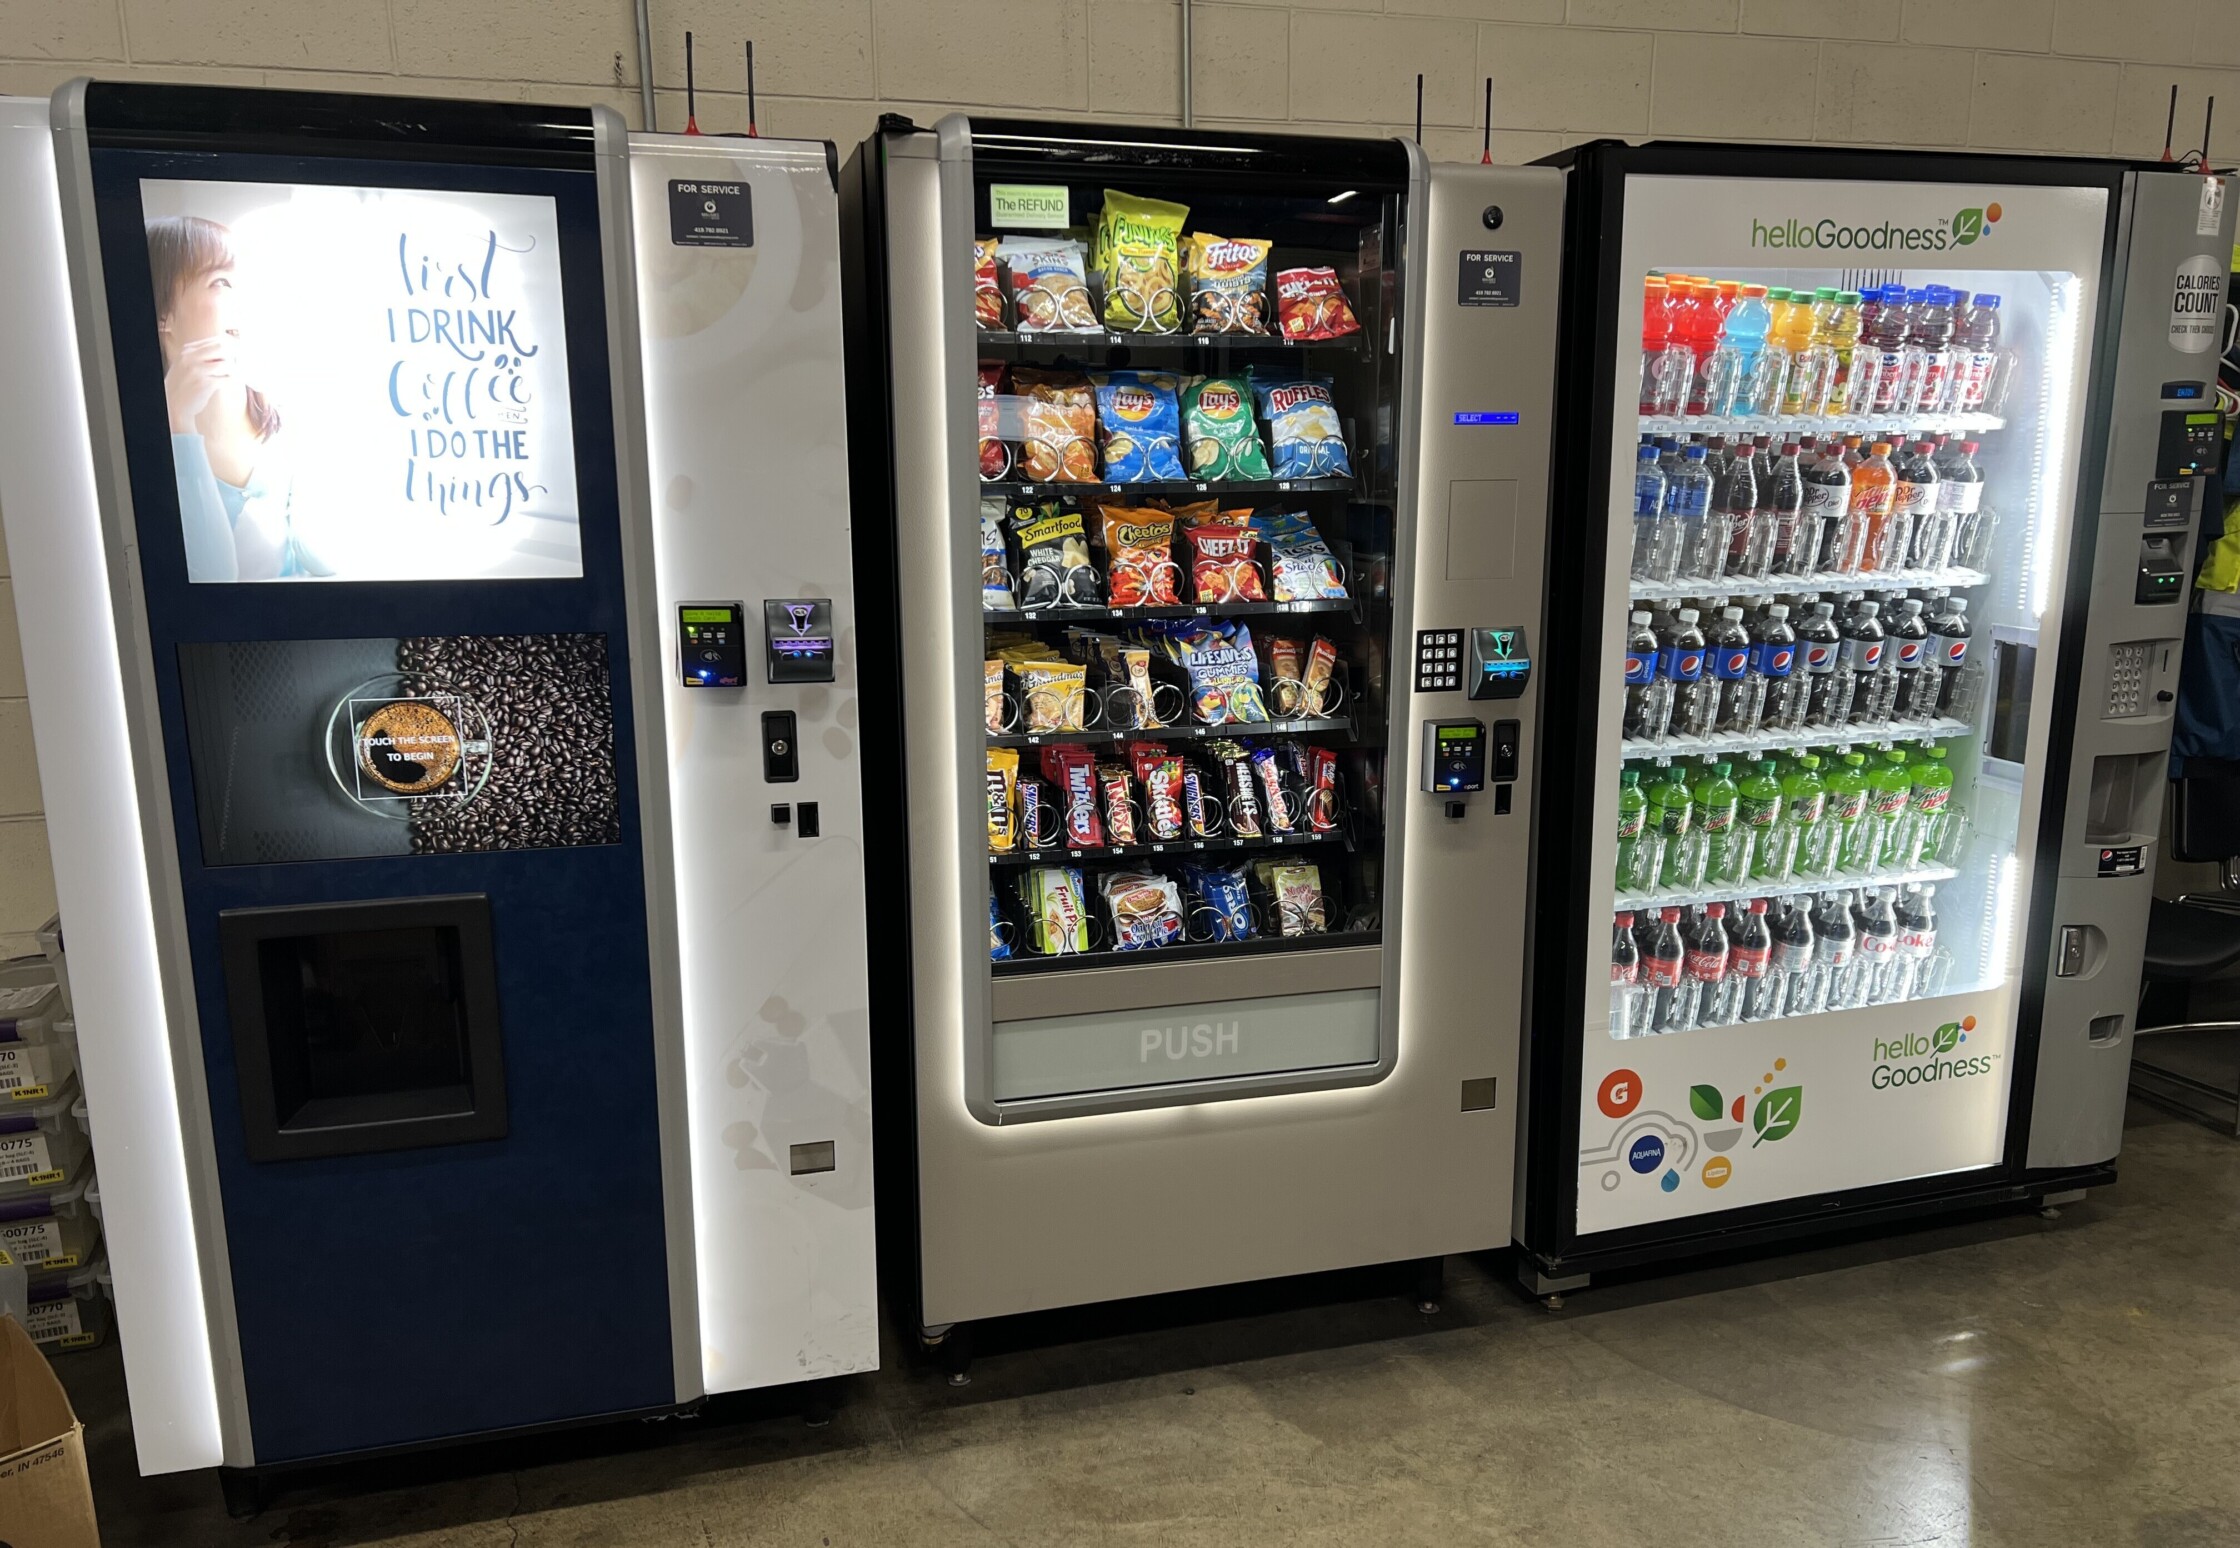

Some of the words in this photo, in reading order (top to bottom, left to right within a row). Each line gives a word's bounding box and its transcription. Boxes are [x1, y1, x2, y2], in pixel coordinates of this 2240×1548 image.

[678, 184, 697, 193] FOR
[701, 185, 740, 195] SERVICE
[996, 198, 1016, 210] The
[1019, 199, 1064, 211] REFUND
[1752, 213, 1947, 250] helloGoodness
[1206, 241, 1260, 270] Fritos
[1484, 254, 1513, 262] SERVICE
[2176, 275, 2221, 291] CALORIES
[2174, 292, 2219, 314] COUNT
[387, 308, 395, 342] I
[408, 308, 538, 361] DRINK
[1110, 336, 1122, 344] 114
[1203, 391, 1239, 410] Lay's
[1271, 385, 1331, 414] RUFFLES
[1458, 414, 1482, 422] SELECT
[410, 429, 418, 457] I
[427, 429, 466, 459] DO
[473, 429, 529, 459] THE
[1025, 518, 1081, 542] Smartfood
[1118, 523, 1172, 547] Cheetos
[1028, 555, 1060, 567] CHEDDAR
[1030, 548, 1054, 558] WHITE
[1112, 609, 1123, 617] 134
[1197, 664, 1249, 679] GUMMIES
[363, 738, 395, 746] TOUCH
[398, 736, 417, 744] THE
[418, 735, 455, 744] SCREEN
[1028, 736, 1039, 744] 142
[1112, 731, 1124, 739] 144
[387, 753, 402, 762] TO
[404, 752, 434, 761] BEGIN
[1185, 773, 1201, 819] SNICKERS
[1235, 761, 1258, 815] HERSHEY'S
[1024, 785, 1037, 834] SNICKERS
[1055, 885, 1074, 913] Fruit
[1141, 1021, 1239, 1063] PUSH
[1873, 1033, 1930, 1061] hello
[1872, 1056, 1991, 1089] Goodness
[14, 1088, 45, 1097] K1NR1
[1610, 1082, 1628, 1105] G
[1631, 1148, 1661, 1161] AQUAFINA
[31, 1172, 61, 1182] K1NR1
[18, 1460, 30, 1472] IN
[33, 1447, 64, 1466] 47546
